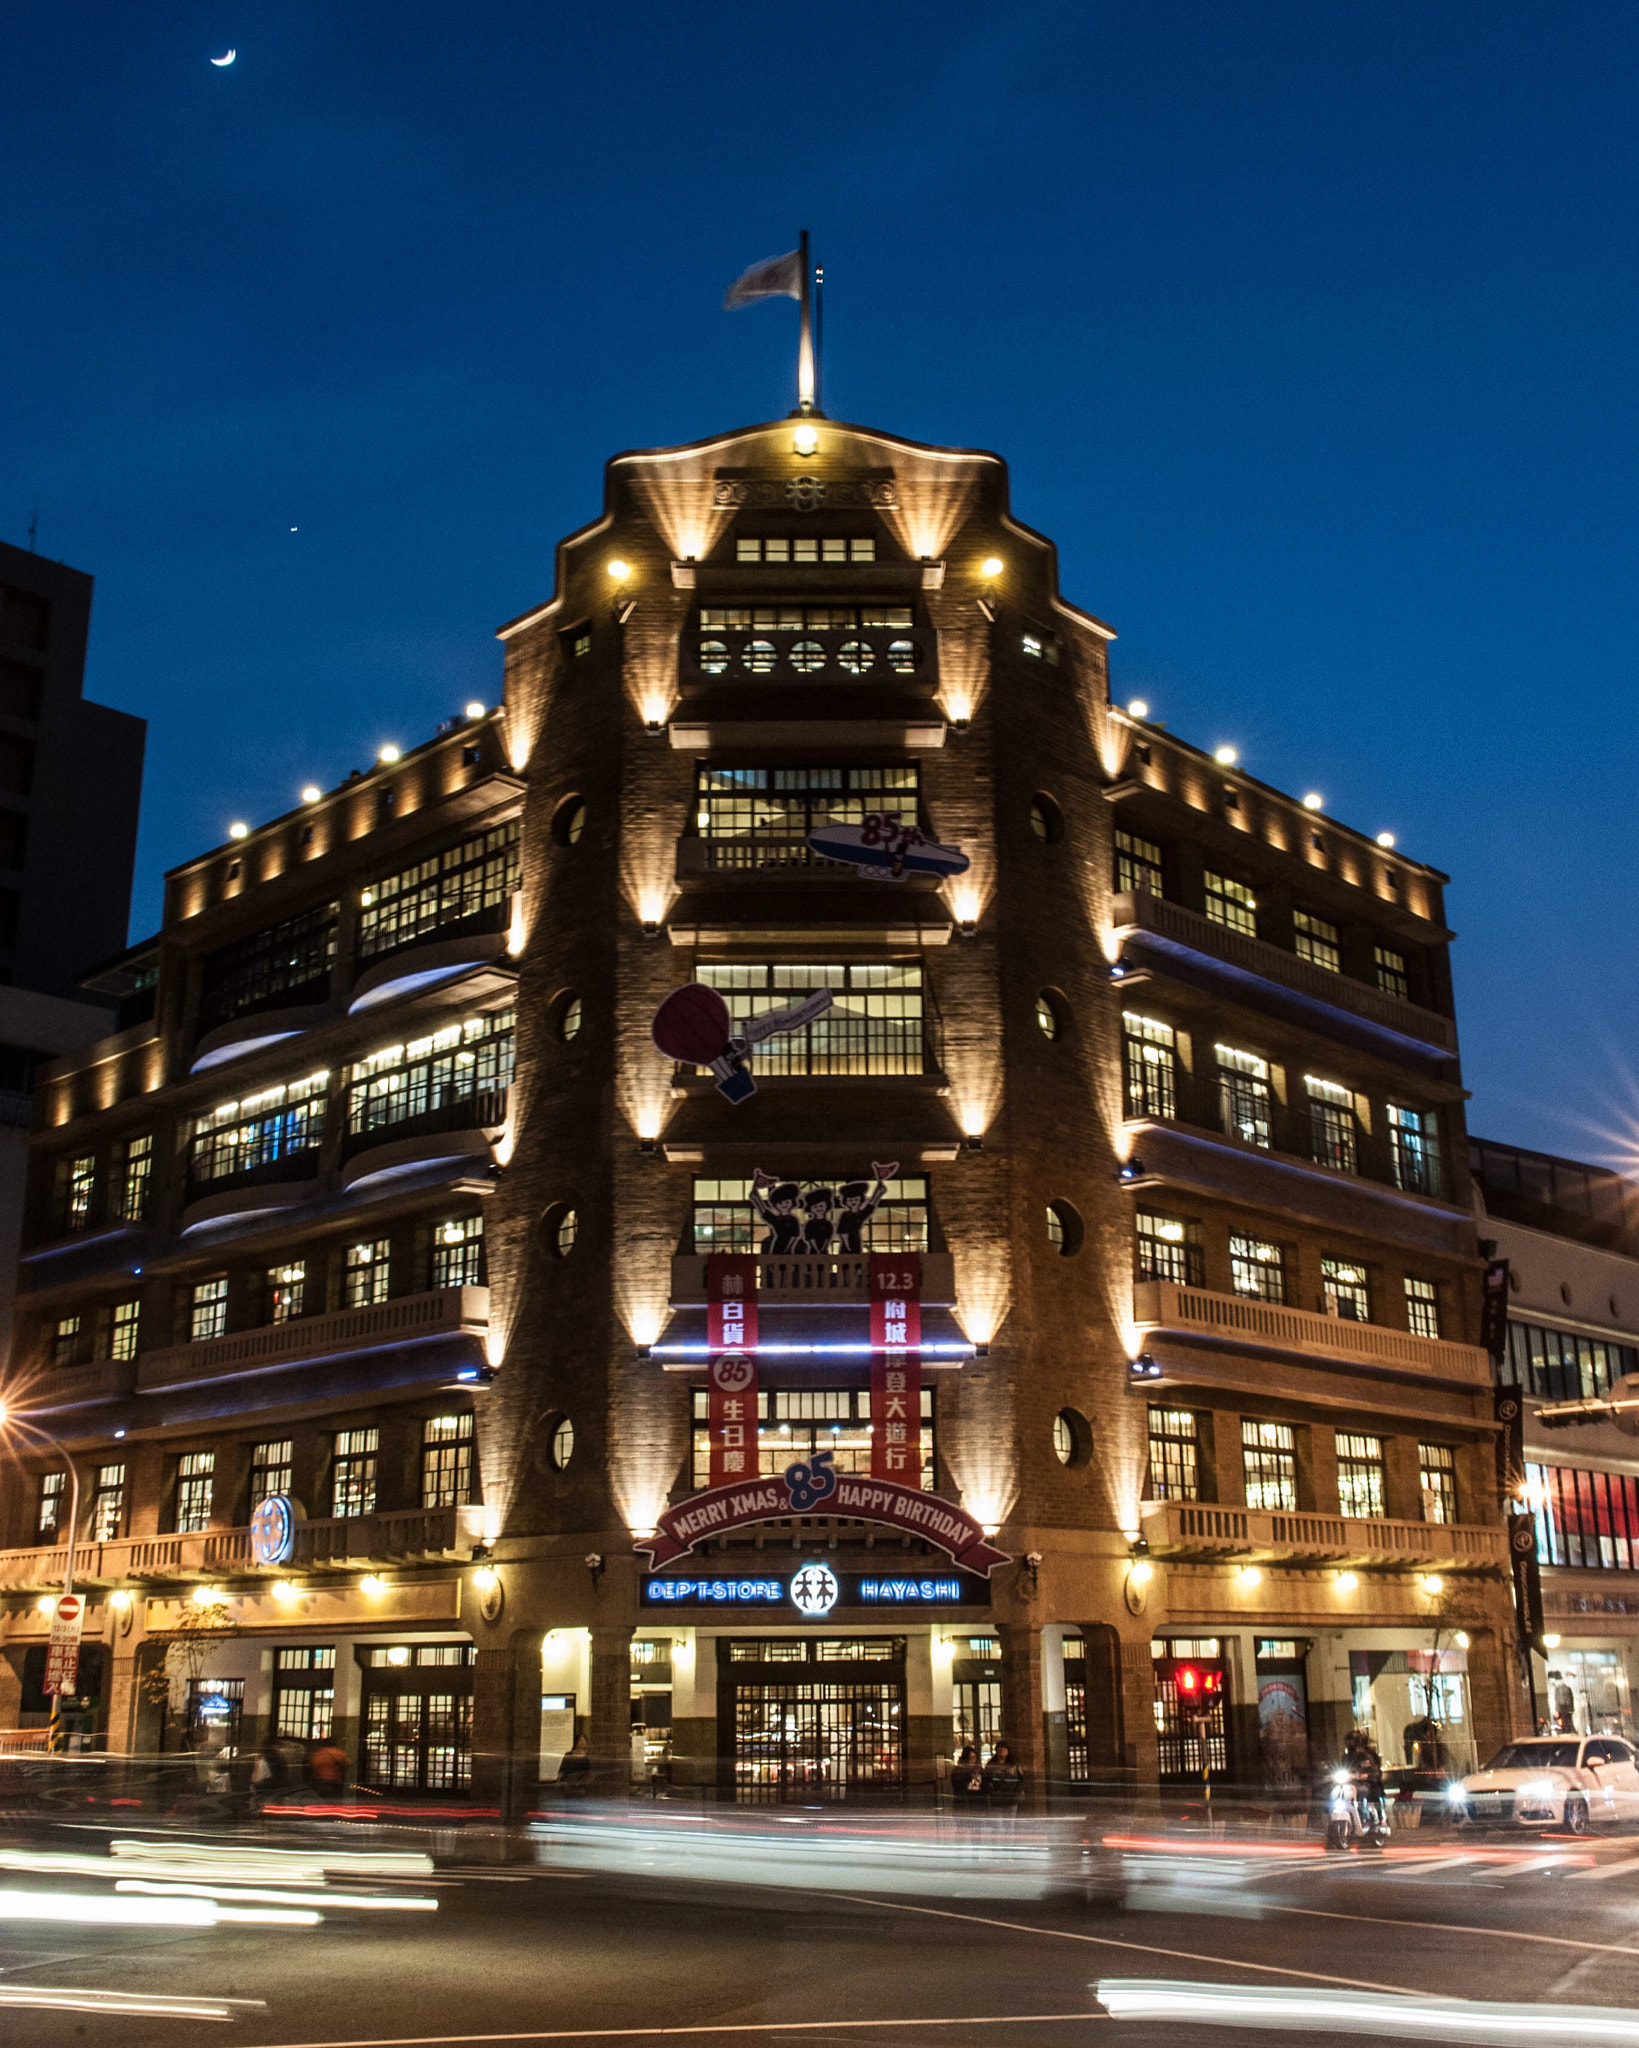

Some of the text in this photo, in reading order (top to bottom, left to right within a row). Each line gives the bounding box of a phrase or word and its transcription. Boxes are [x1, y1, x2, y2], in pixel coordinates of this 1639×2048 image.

[876, 1272, 914, 1290] 12.3
[718, 1360, 749, 1383] 85
[672, 1450, 974, 1546] MERRY XMAS & 85 HAPPY BIRTHDAY
[861, 1580, 961, 1599] HAYASHI
